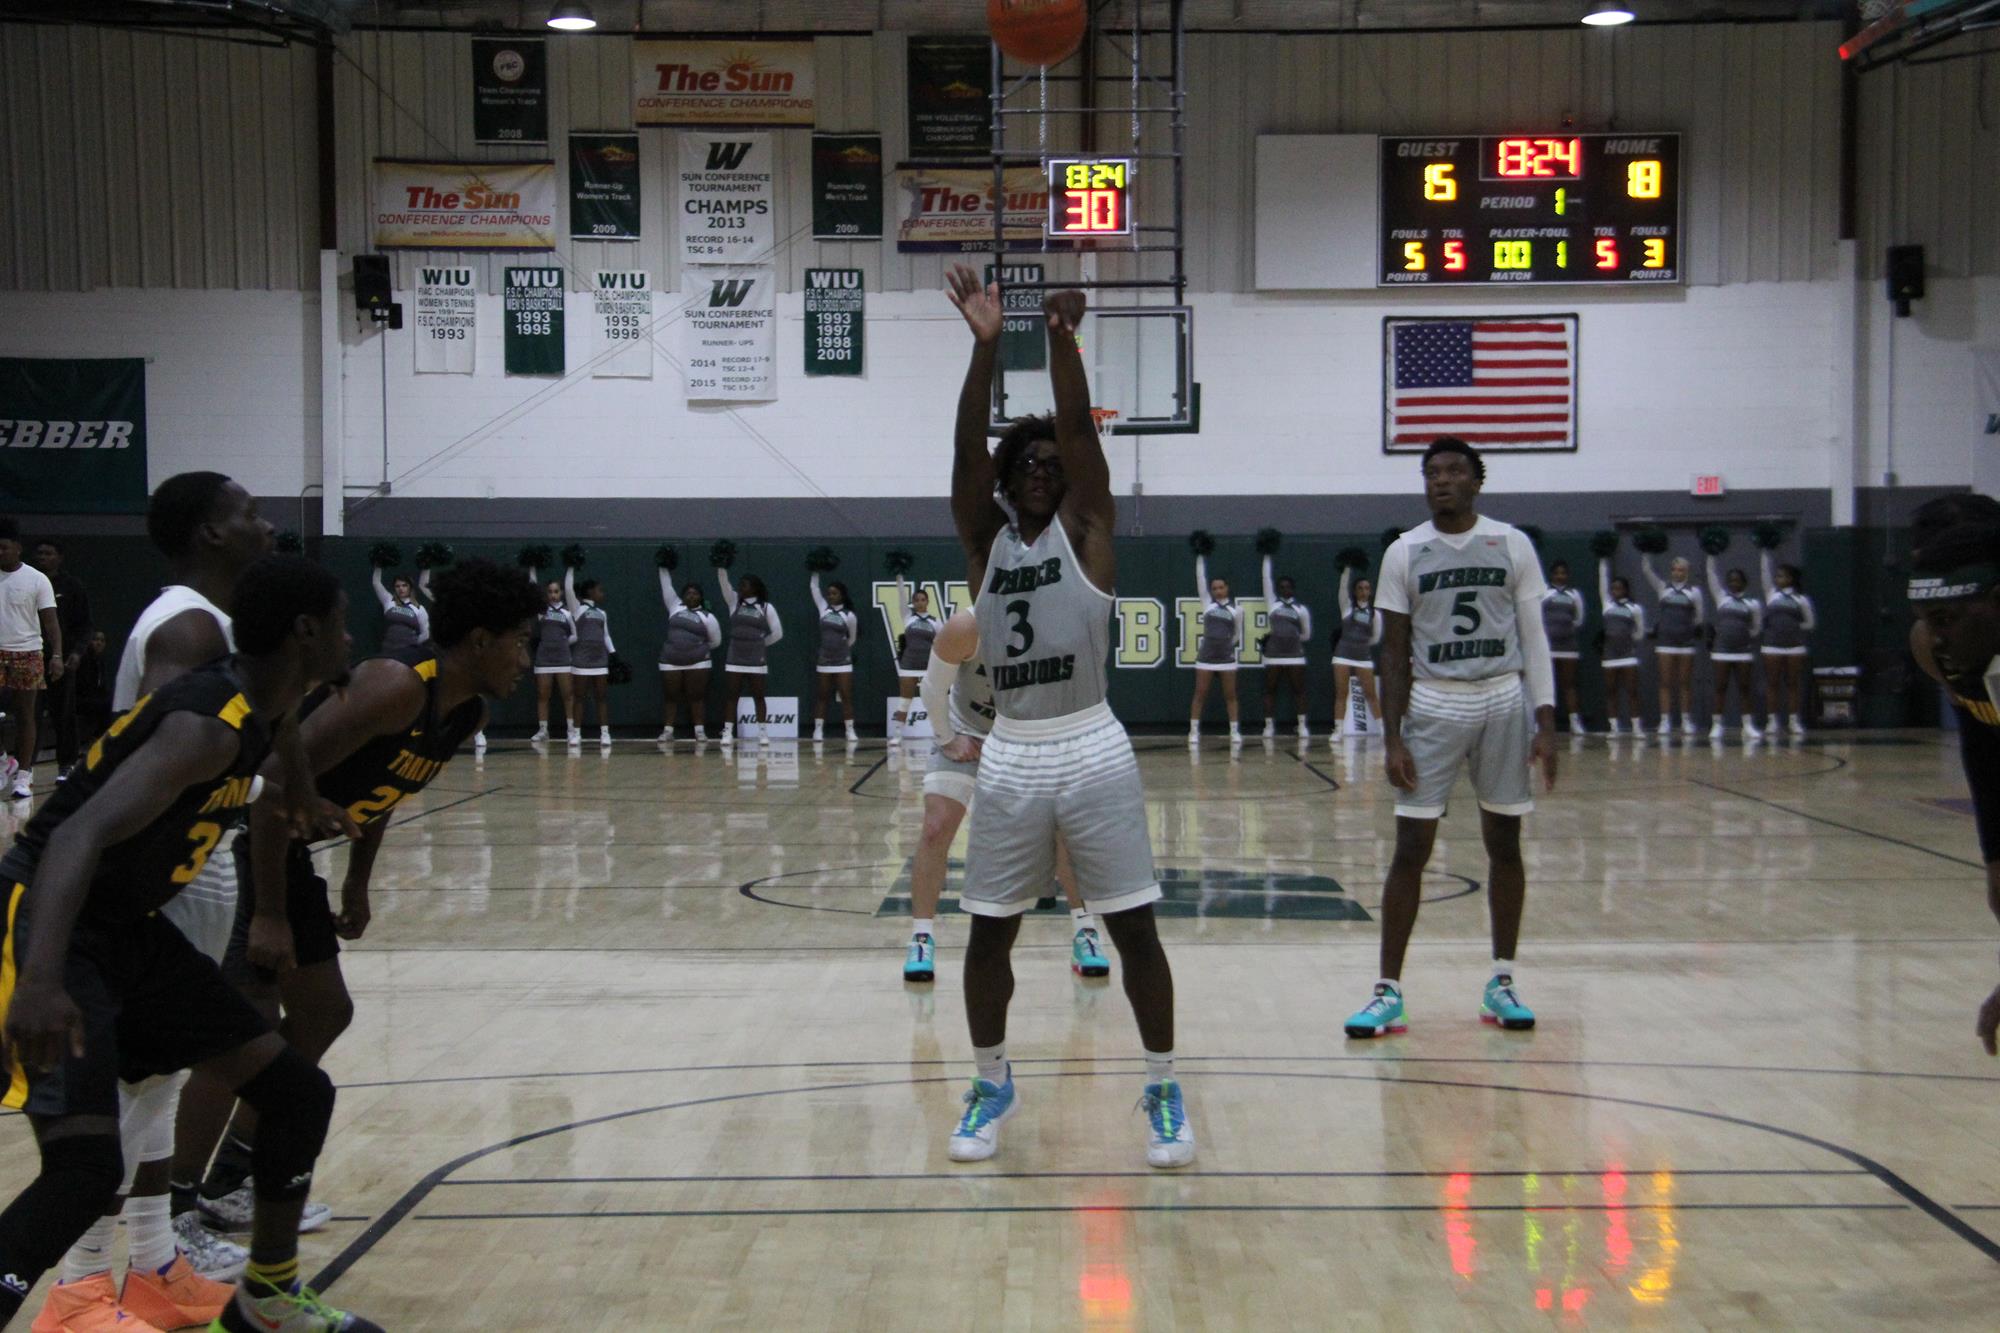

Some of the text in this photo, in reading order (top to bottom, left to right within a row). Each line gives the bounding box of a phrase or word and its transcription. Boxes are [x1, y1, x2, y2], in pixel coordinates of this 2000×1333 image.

[656, 62, 794, 92] The Sun
[638, 98, 813, 109] CONFERENCE CHAMPIONS
[1397, 142, 1459, 157] GUEST
[1604, 140, 1660, 154] HOME
[705, 142, 753, 170] W
[705, 174, 771, 182] CONFERENCE
[689, 184, 762, 192] TOURNAMENT
[406, 185, 521, 209] The Sun
[920, 187, 981, 212] The
[1480, 196, 1535, 209] PERIOD
[685, 199, 768, 214] CHAMPS
[1065, 191, 1118, 230] 30
[378, 214, 552, 226] CONFERENCE CHAMPIONS
[707, 216, 746, 229] 2013
[592, 224, 617, 234] 2009
[835, 224, 859, 234] 2009
[1391, 229, 1463, 239] FOULS TOL
[1489, 228, 1569, 239] PLAYER-FOUL
[1593, 226, 1668, 237] TOL FOULS
[686, 235, 754, 244] RECORD 16-14
[687, 246, 724, 254] TSC 8-6
[1404, 241, 1468, 271] 5 5
[1596, 238, 1665, 269] 5 3
[422, 269, 470, 286] WIU
[511, 270, 559, 288] WIU
[598, 273, 645, 289] WIU
[811, 271, 859, 289] WIU
[1386, 273, 1429, 282] POINTS
[1490, 271, 1532, 281] MATCH
[1629, 270, 1671, 280] POINTS
[708, 279, 756, 307] W
[1018, 295, 1043, 308] GOLF
[515, 311, 551, 323] 1993
[684, 309, 773, 318] SUN CONFERENCE
[816, 312, 851, 325] 1993
[605, 315, 640, 327] 1995
[691, 320, 765, 329] TOURNAMENT
[431, 328, 466, 340] 1993
[515, 324, 551, 336] 1995
[605, 328, 640, 340] 1996
[816, 325, 851, 336] 1997
[816, 336, 851, 349] 1998
[817, 348, 851, 361] 2001
[690, 359, 716, 368] 2014
[690, 379, 716, 388] 2015
[1697, 476, 1720, 494] EXIT
[1451, 591, 1480, 635] 5
[1006, 599, 1034, 658] 3
[347, 785, 401, 825] 2
[171, 822, 222, 884] 3
